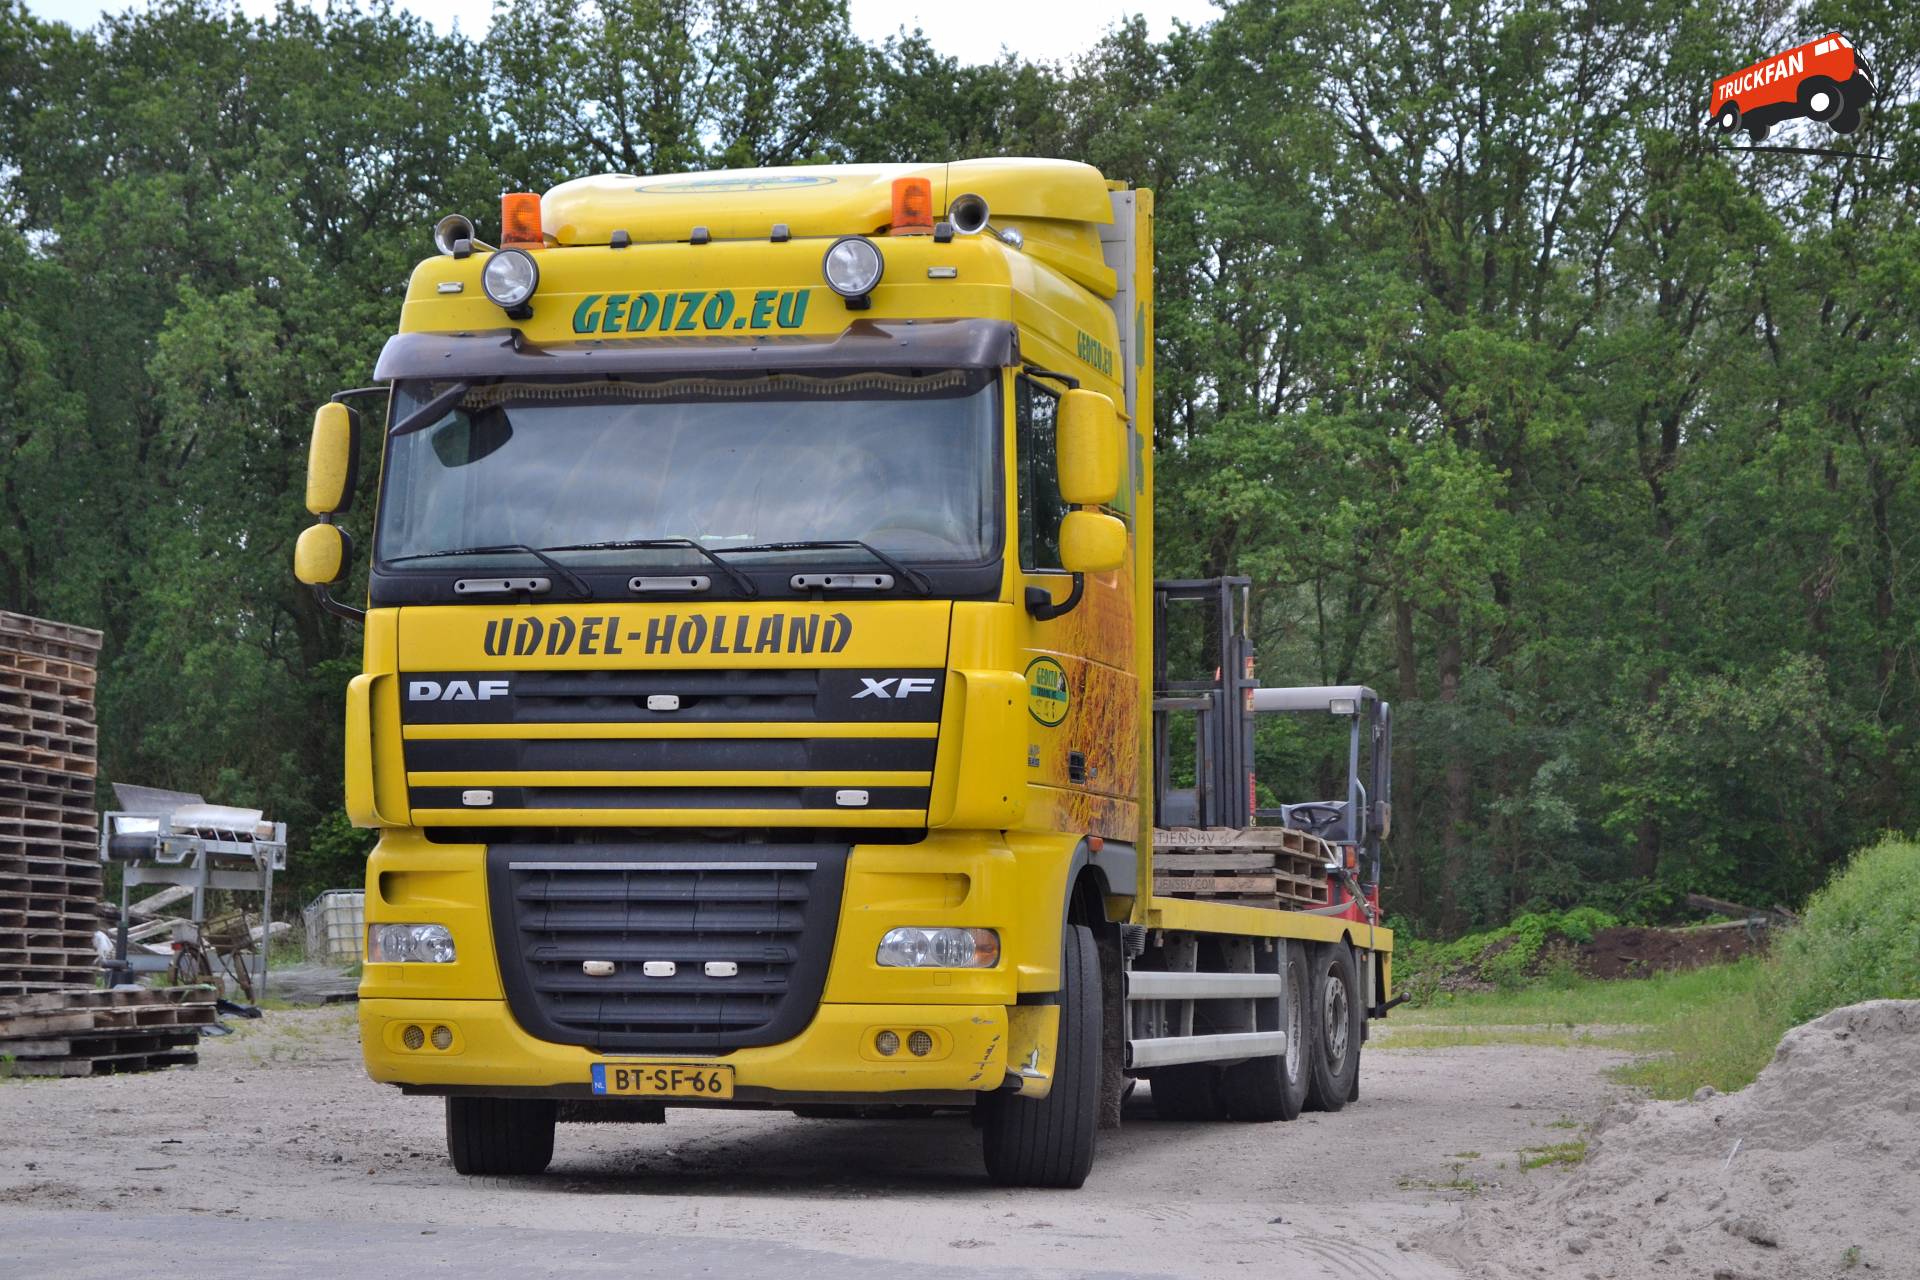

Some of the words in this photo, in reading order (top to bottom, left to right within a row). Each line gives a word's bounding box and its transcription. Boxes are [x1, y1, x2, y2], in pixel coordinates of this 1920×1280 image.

[572, 289, 810, 334] GEDIZO.EU
[484, 612, 853, 656] UDDEL-HOLLAND
[408, 680, 510, 701] DAF
[850, 678, 936, 699] XF
[1153, 832, 1215, 844] TJENSBV
[594, 1081, 605, 1090] NL
[615, 1069, 723, 1093] BT-SF-66
